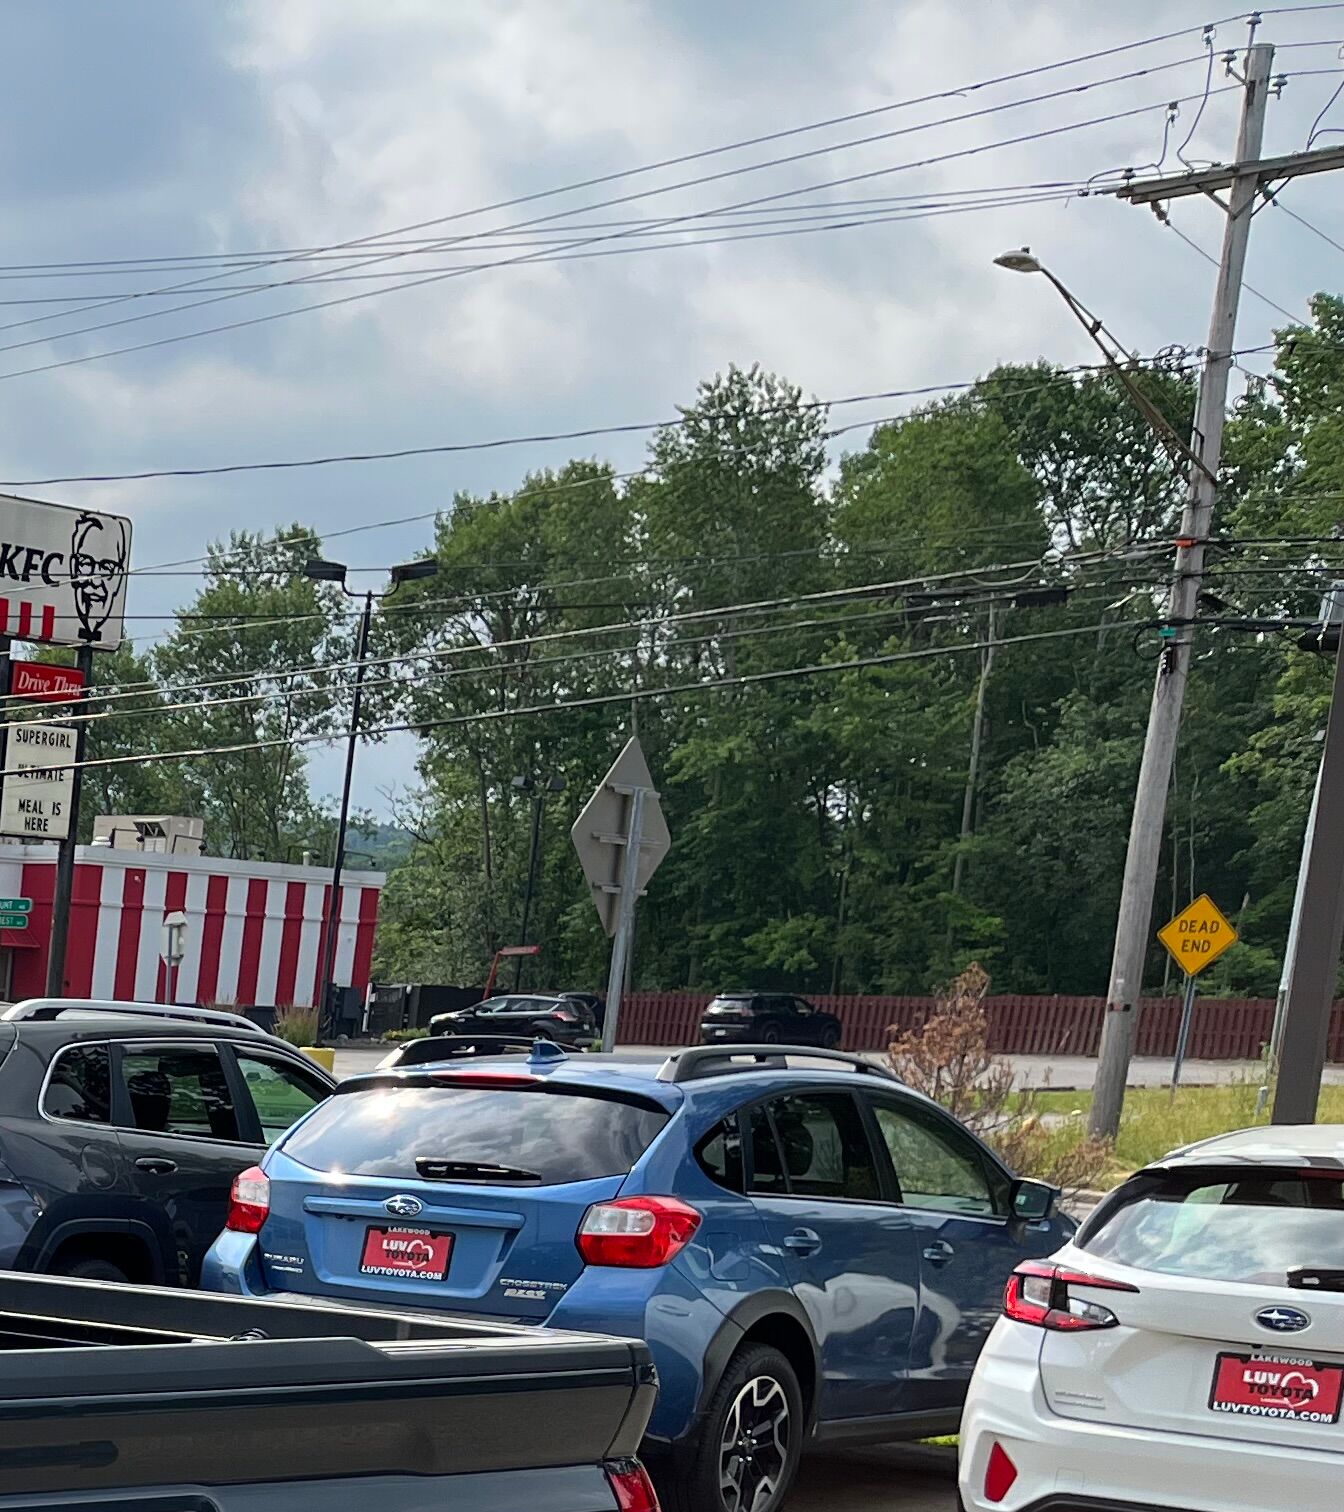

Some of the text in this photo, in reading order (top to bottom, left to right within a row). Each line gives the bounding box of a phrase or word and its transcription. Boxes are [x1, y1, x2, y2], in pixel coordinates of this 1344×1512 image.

[18, 671, 82, 696] Drive Thru
[16, 728, 71, 748] SUPERGIRL
[18, 799, 61, 816] MEAL IS
[24, 817, 49, 832] HERE
[1179, 920, 1220, 934] DEAD
[1182, 939, 1211, 953] END
[388, 1227, 431, 1235] LAKEWOOD
[382, 1239, 408, 1252] LUV
[385, 1249, 430, 1263] TOYOTA
[361, 1264, 443, 1280] LUVTOYOTA.COM
[1250, 1353, 1313, 1367] LAKEWOOD
[1242, 1369, 1282, 1386] LUV
[1248, 1383, 1314, 1401] TOYOTA
[1213, 1400, 1333, 1424] LUVTOYOTA.COM
